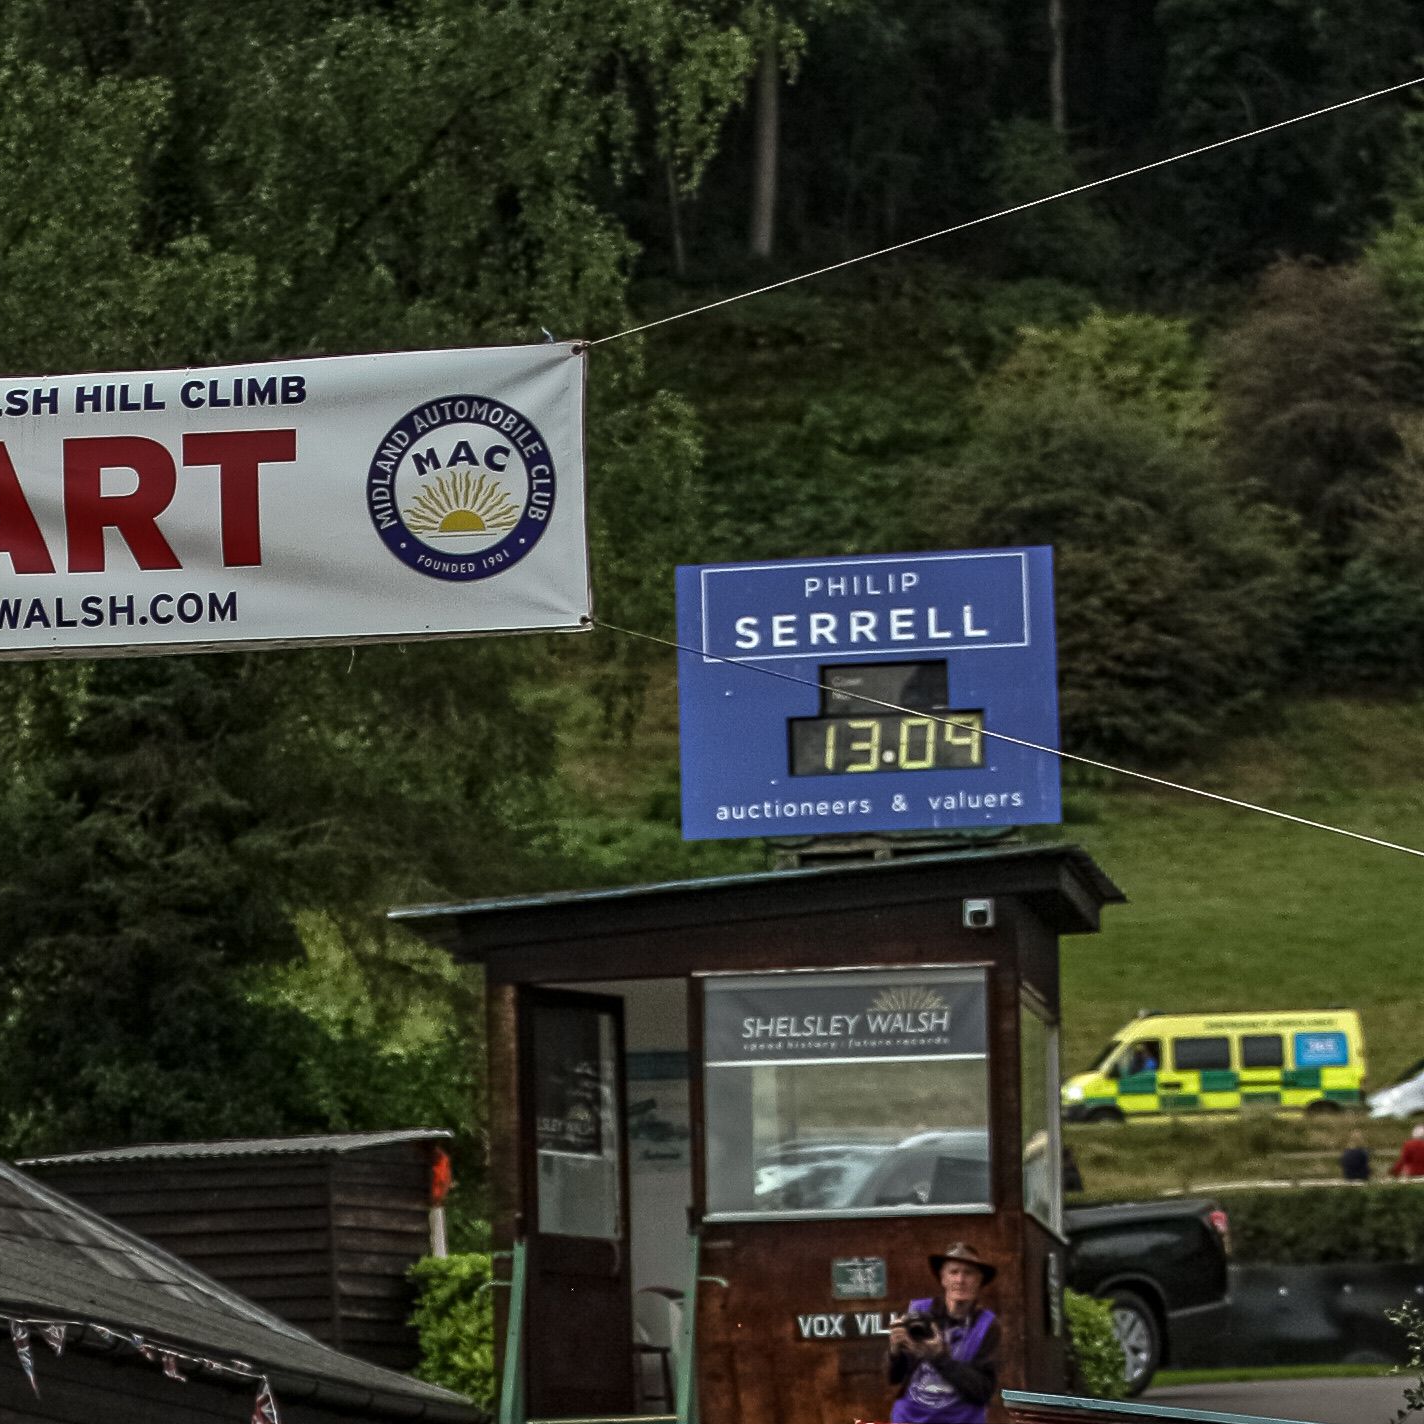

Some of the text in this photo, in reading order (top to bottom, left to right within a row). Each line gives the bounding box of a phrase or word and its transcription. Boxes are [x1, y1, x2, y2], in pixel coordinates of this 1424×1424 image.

[74, 383, 166, 414] HILL
[180, 375, 307, 409] CLIMB
[372, 400, 552, 530] MIDLAND AUTOMOBILE CLUB
[411, 440, 511, 477] MAC
[417, 548, 510, 574] FOUNDED 1901
[804, 572, 919, 598] PHILIP
[734, 605, 990, 650] SERRELL
[824, 714, 983, 773] 13.09
[716, 790, 1023, 821] auctioneers & valuers
[742, 1011, 951, 1038] SHELSLEY WALSH
[797, 1313, 846, 1338] VOX
